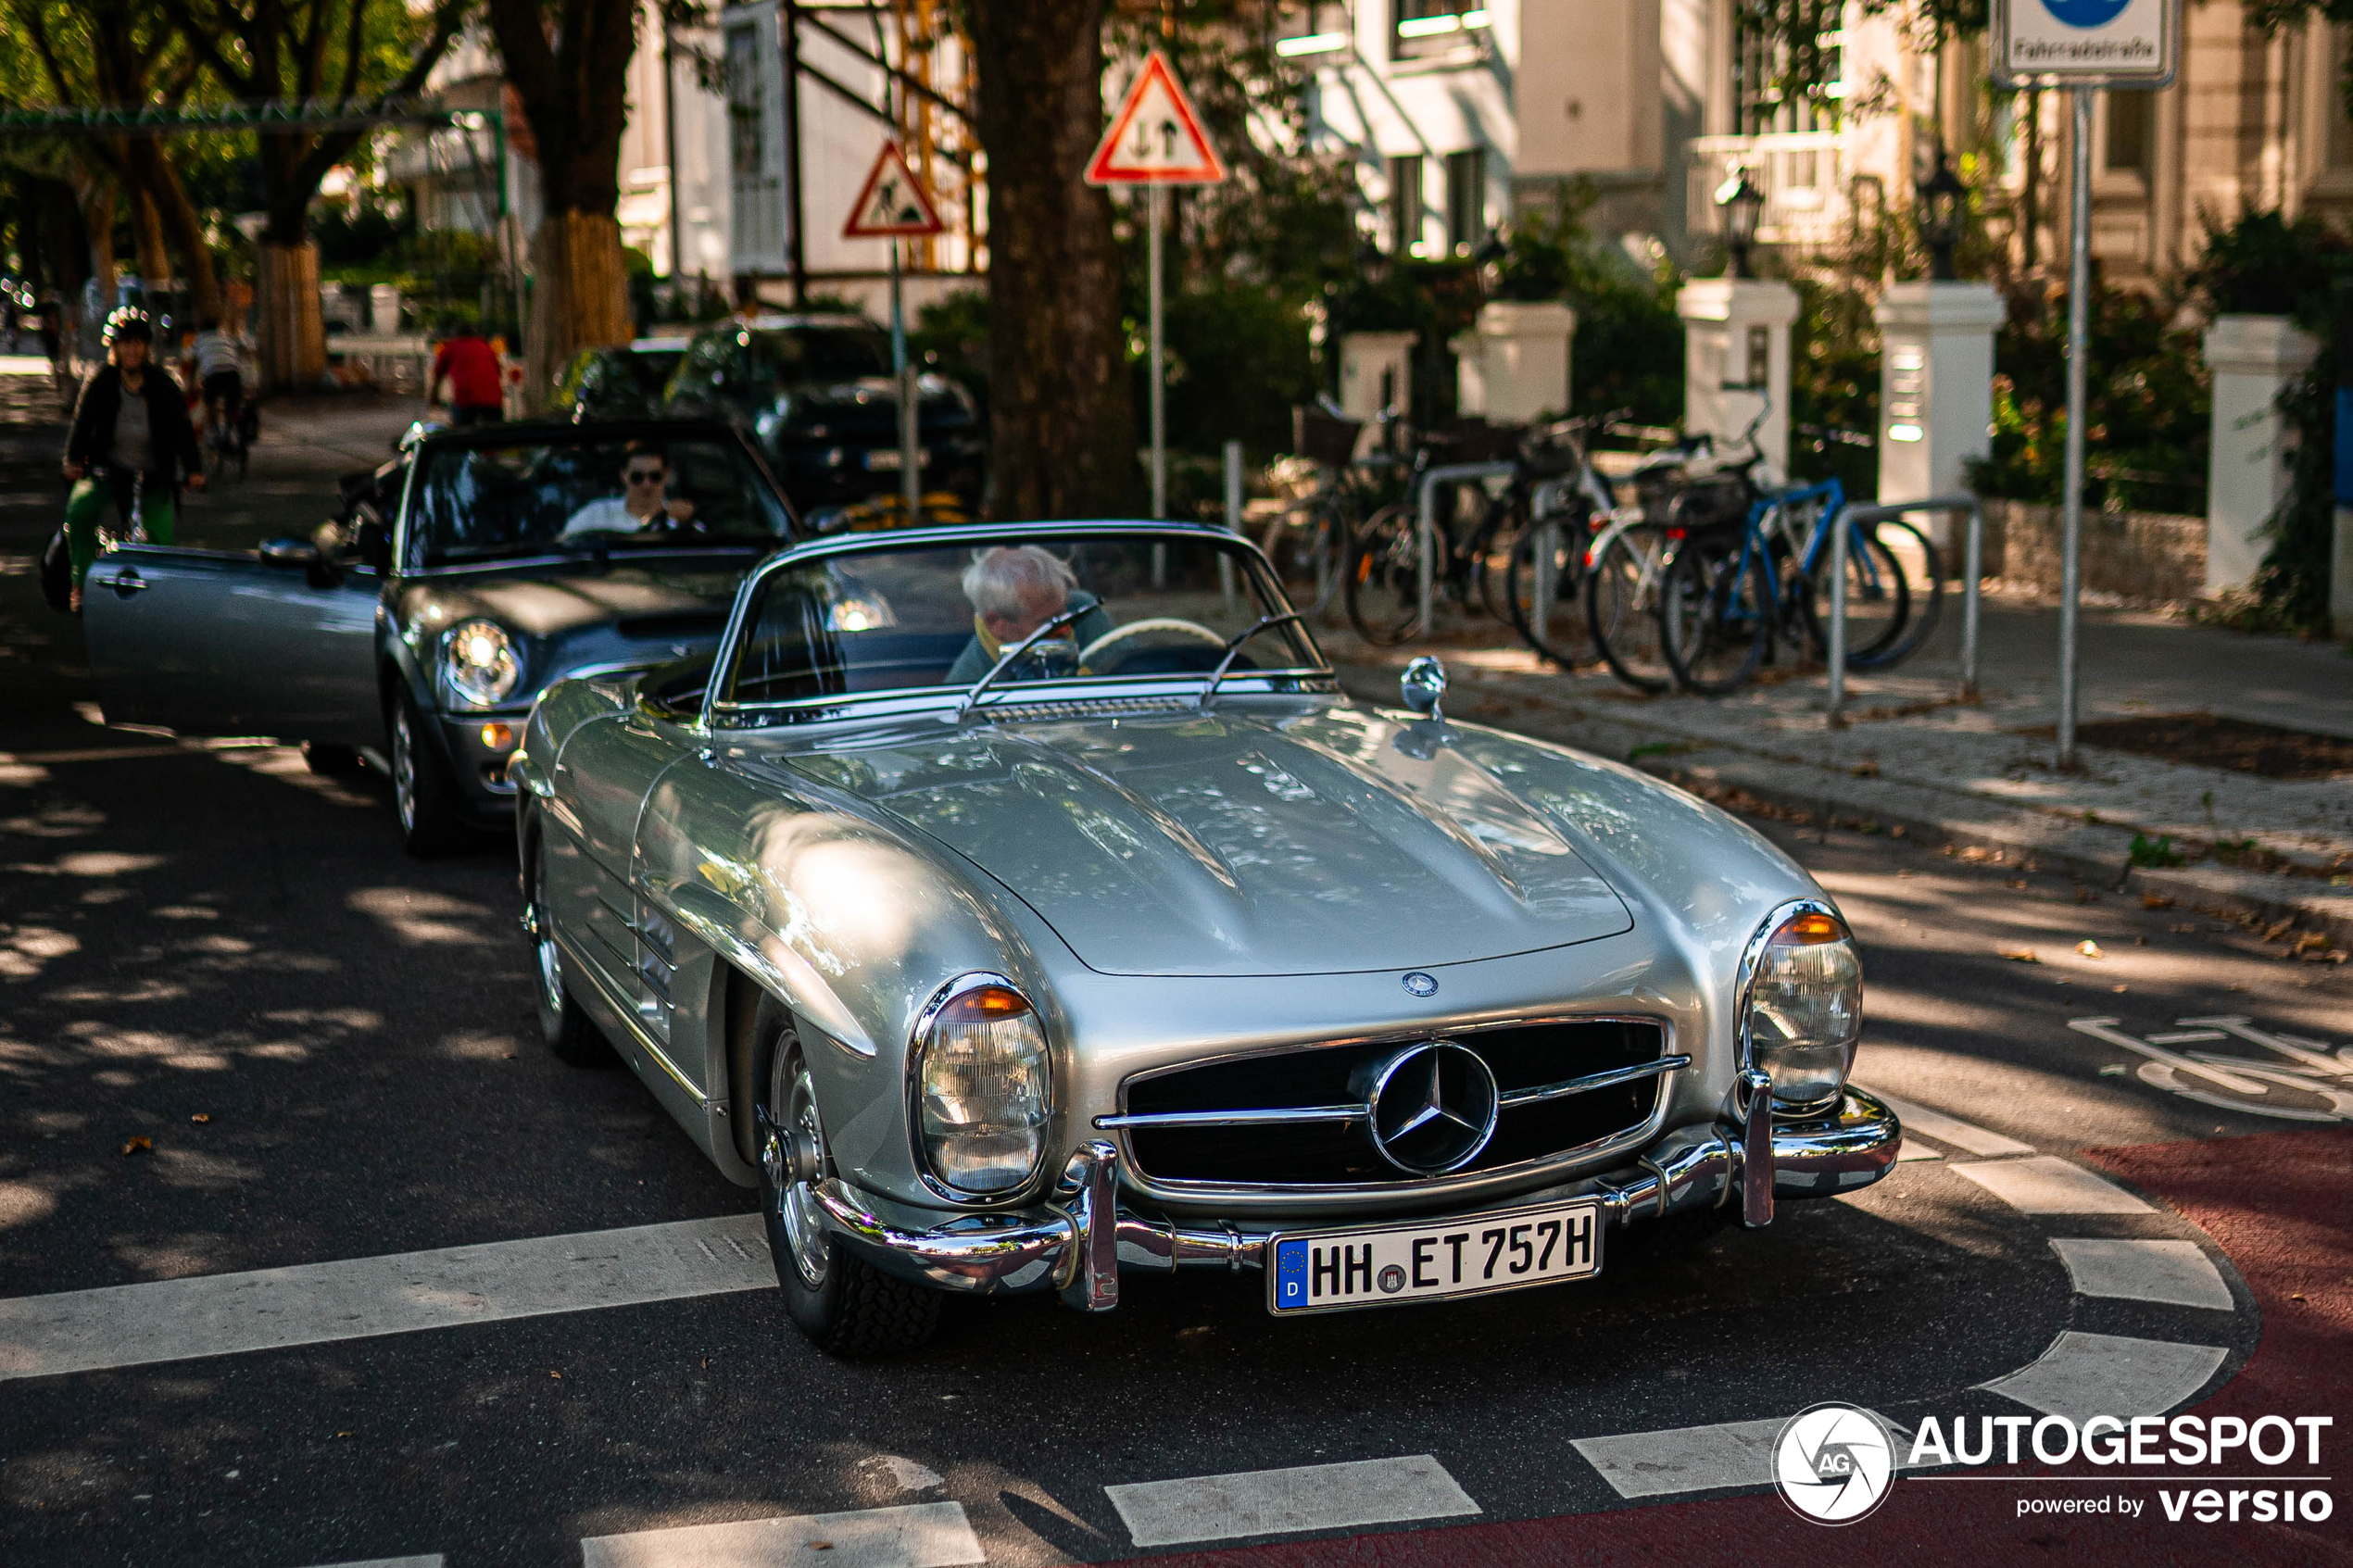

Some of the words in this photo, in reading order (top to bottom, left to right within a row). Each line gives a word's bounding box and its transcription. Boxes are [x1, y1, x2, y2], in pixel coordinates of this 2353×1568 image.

[2013, 36, 2155, 58] Fahrradstraße
[1312, 1243, 1372, 1297] HH
[1412, 1233, 1470, 1288] ET
[1481, 1215, 1592, 1280] 757H
[1287, 1282, 1299, 1297] D
